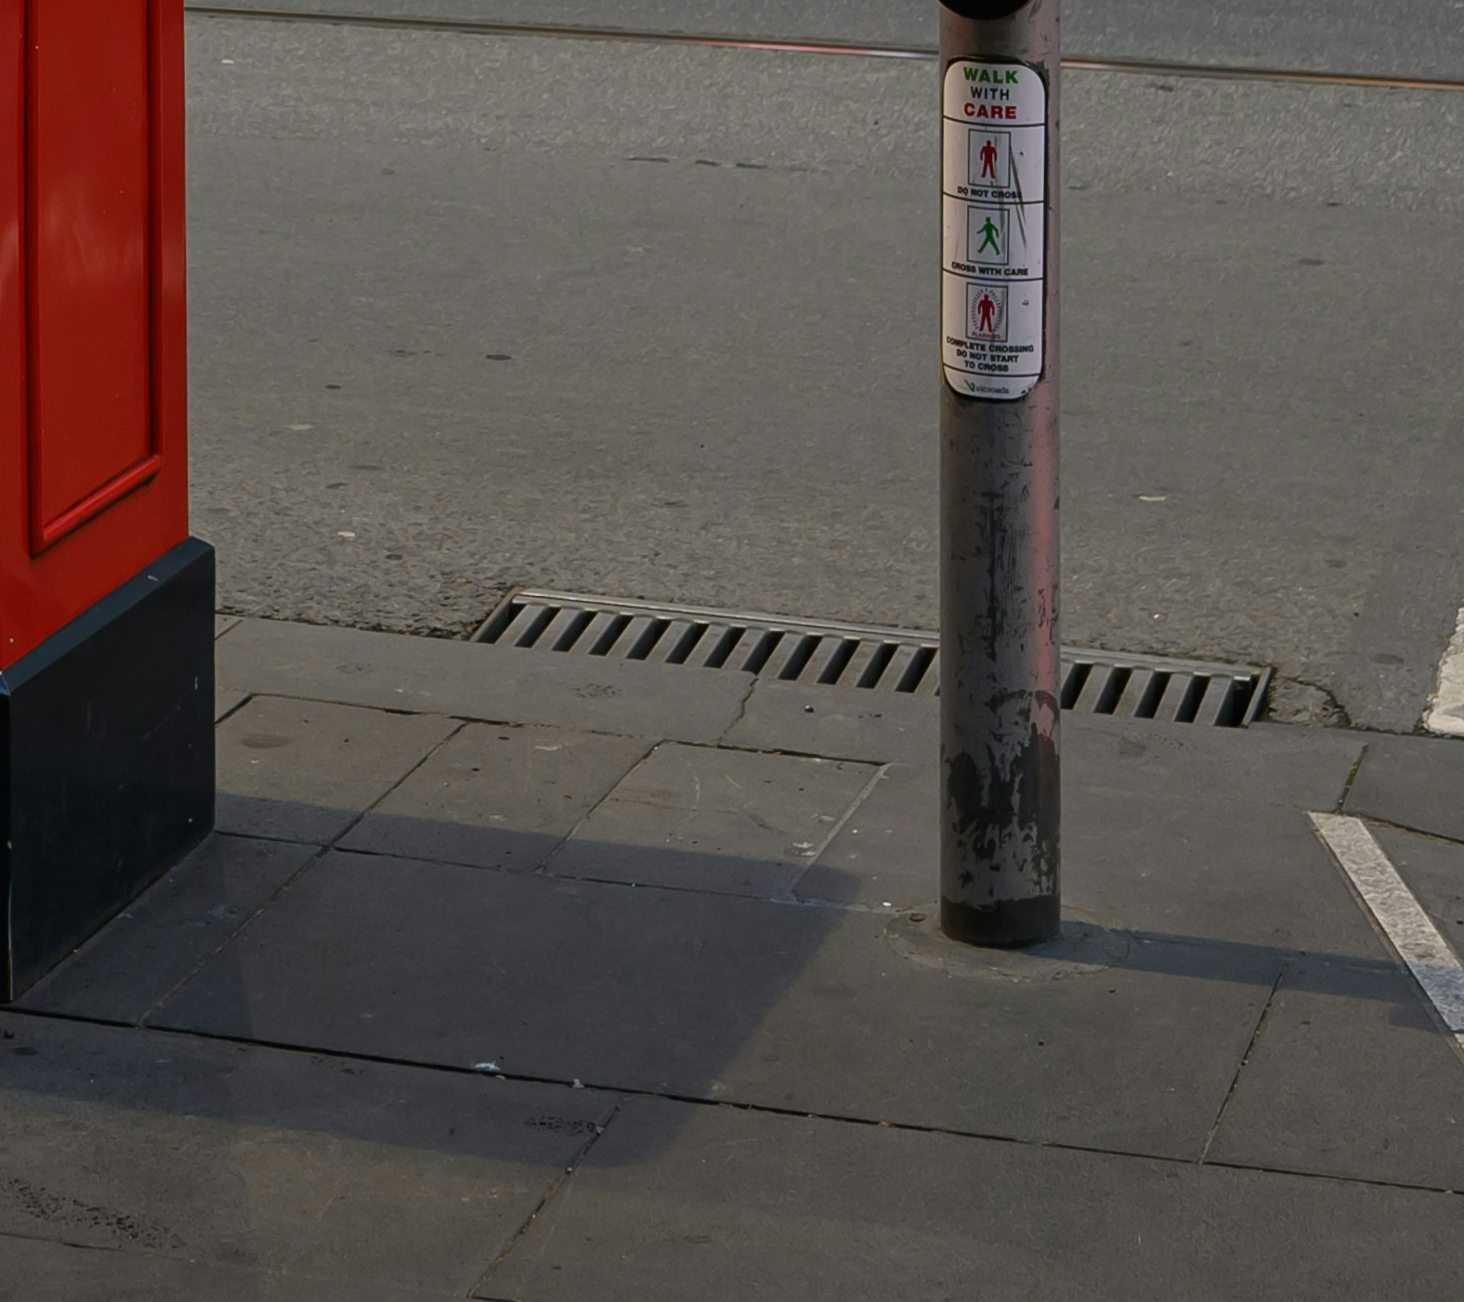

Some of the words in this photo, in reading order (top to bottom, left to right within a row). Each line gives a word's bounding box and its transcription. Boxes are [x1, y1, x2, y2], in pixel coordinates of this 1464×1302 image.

[963, 66, 1019, 84] WALK
[971, 86, 1010, 101] WITH
[964, 102, 1017, 119] CARE
[957, 186, 969, 195] DO
[970, 188, 989, 198] NOT
[991, 190, 1022, 199] CROSS
[951, 261, 976, 273] CROSS
[978, 266, 1002, 276] WITH
[1004, 268, 1029, 276] CARE
[947, 336, 986, 352] COMPLETE
[989, 344, 1034, 353] CROSSING
[956, 349, 967, 358] DO
[969, 352, 987, 361] NOT
[990, 354, 1019, 363] START
[964, 360, 975, 369] TO
[978, 362, 1009, 372] CROSS
